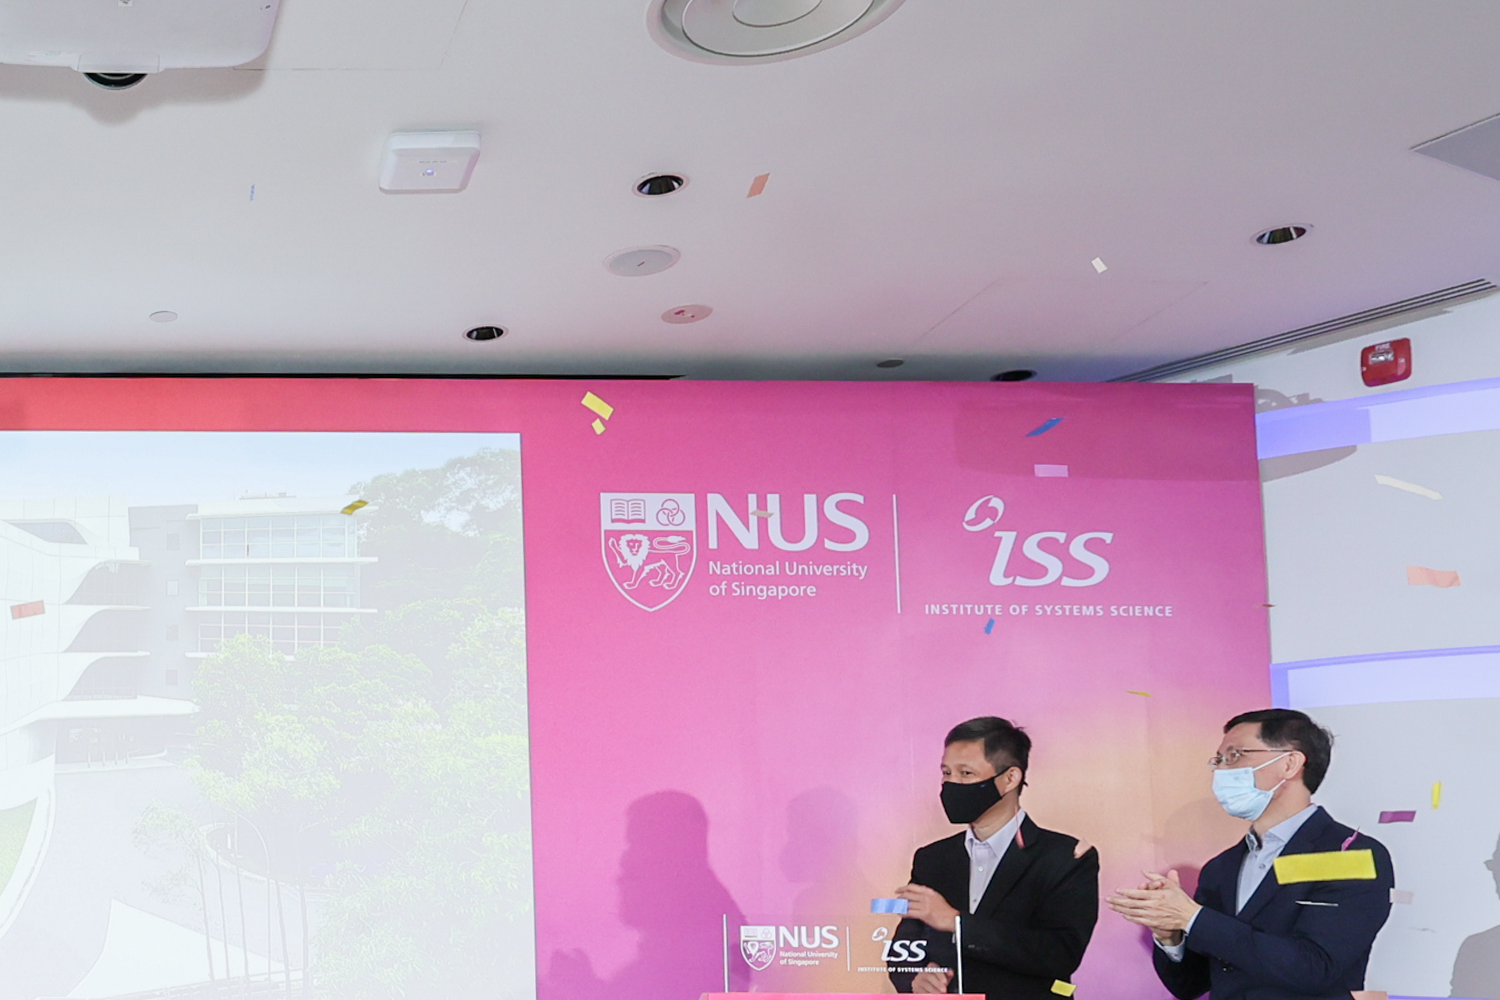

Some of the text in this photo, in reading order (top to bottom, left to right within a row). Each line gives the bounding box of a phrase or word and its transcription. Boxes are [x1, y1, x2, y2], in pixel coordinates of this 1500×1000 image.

[706, 492, 870, 551] NUS
[708, 561, 868, 580] National University
[709, 581, 817, 600] of Singapore
[924, 603, 1173, 618] INSTITUTE OF SYSTEMS SCIENCE
[779, 925, 840, 949] NUS
[779, 950, 839, 959] National University
[779, 958, 820, 967] of Singapore
